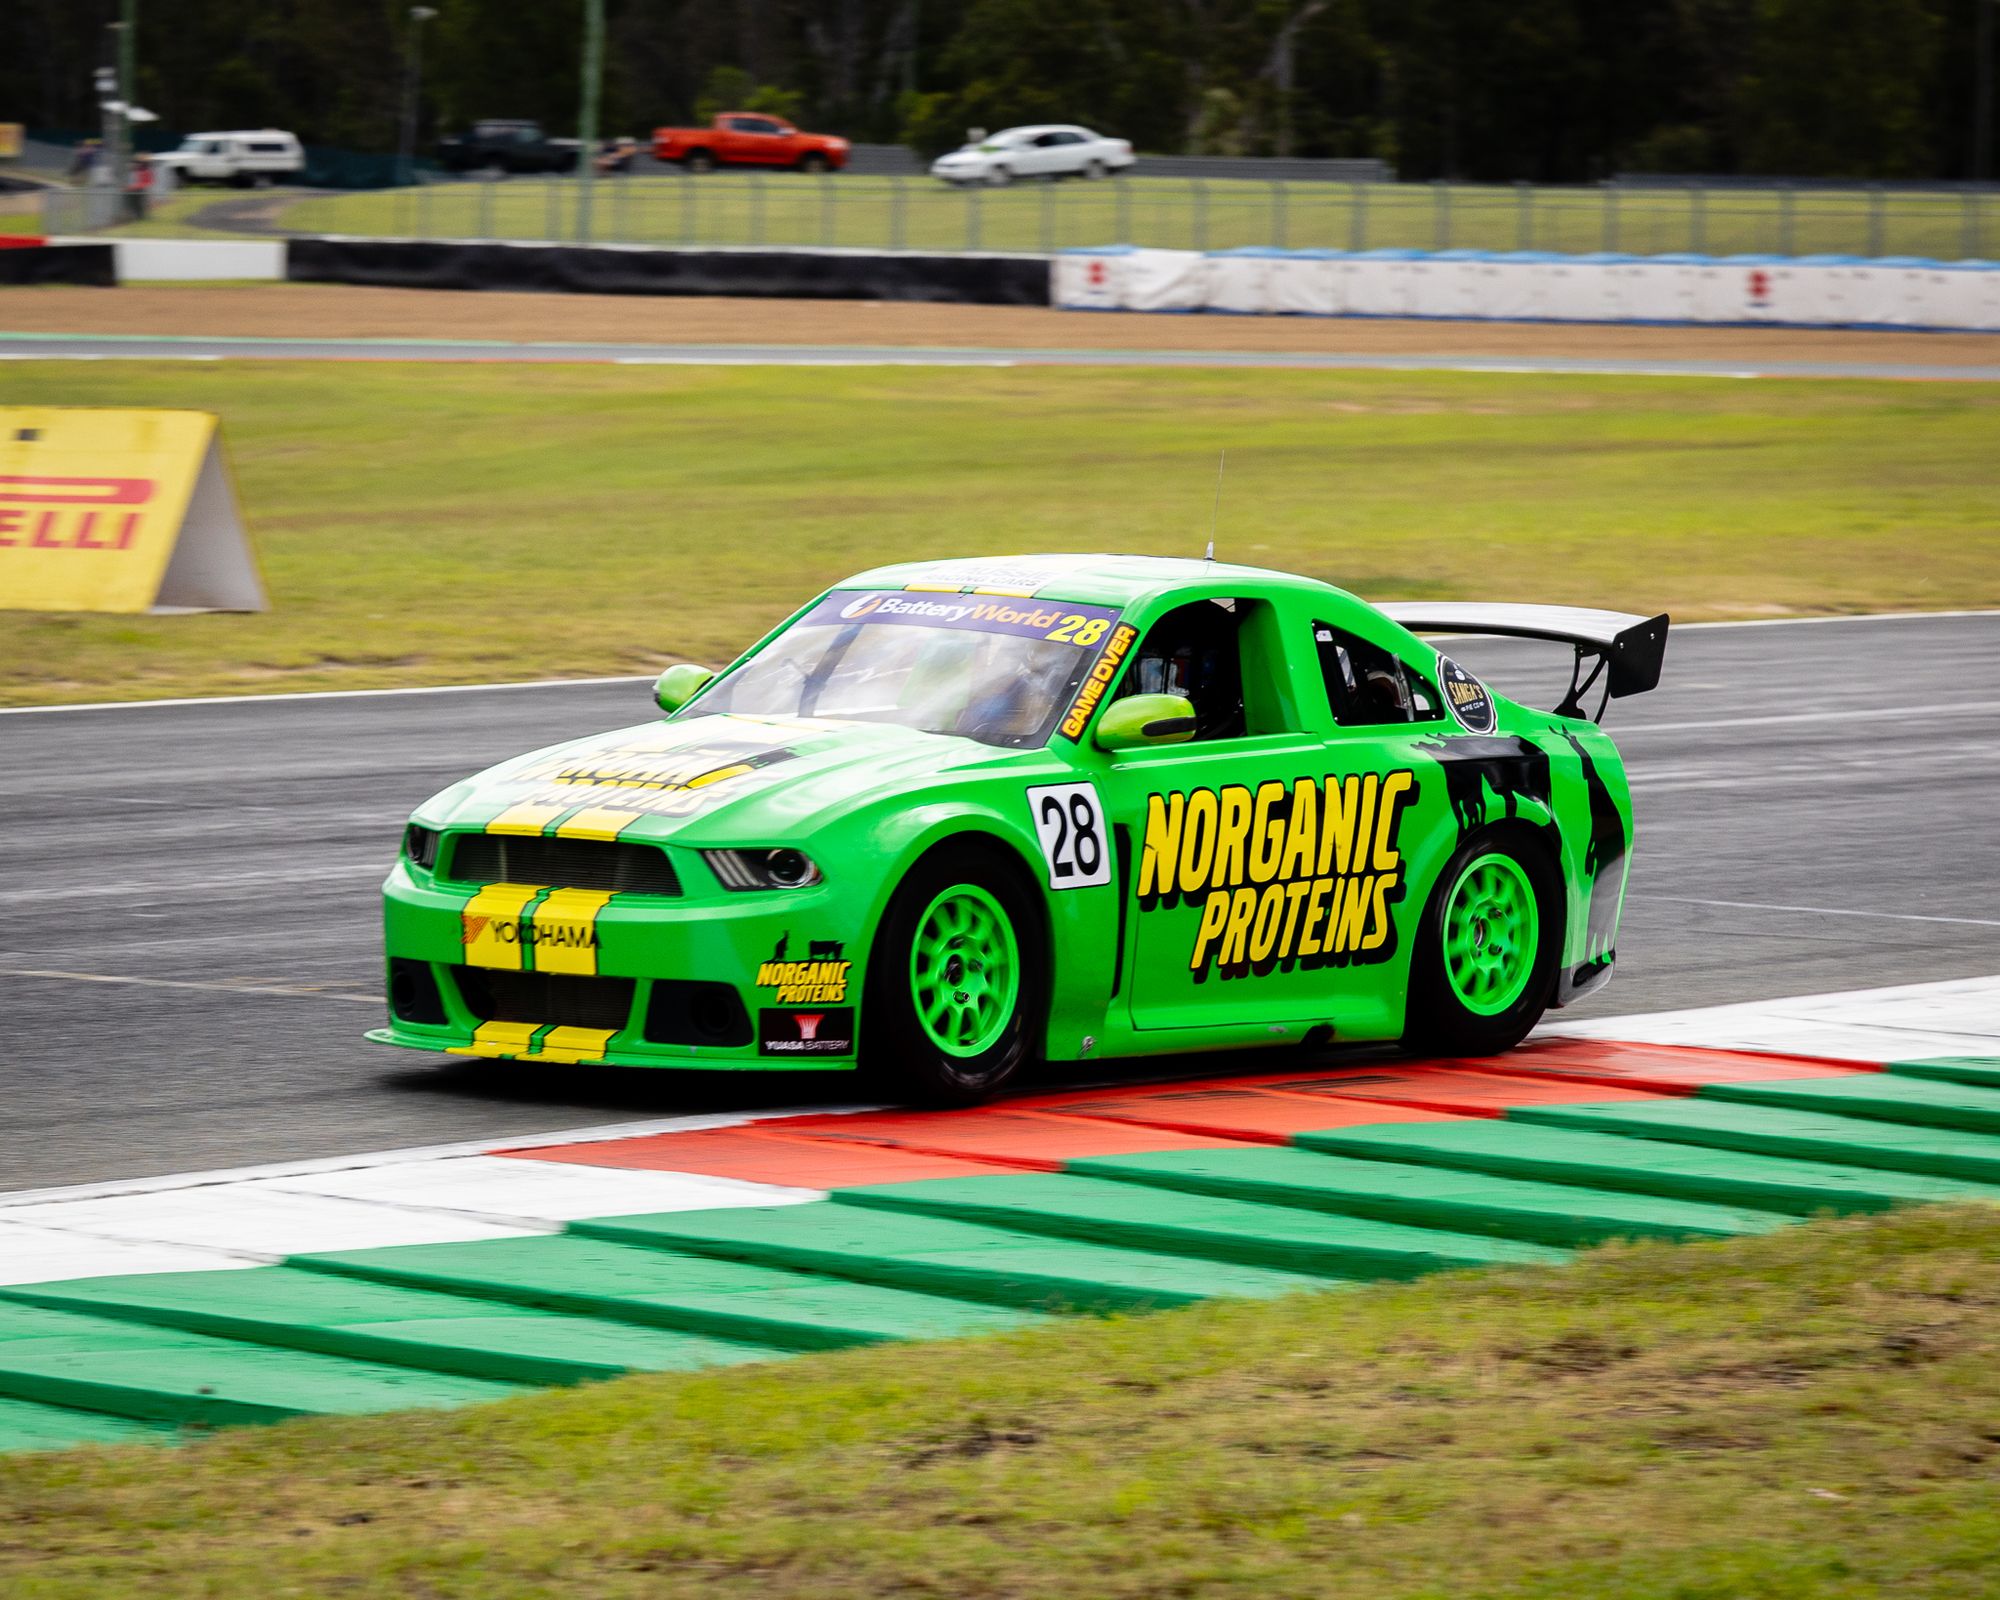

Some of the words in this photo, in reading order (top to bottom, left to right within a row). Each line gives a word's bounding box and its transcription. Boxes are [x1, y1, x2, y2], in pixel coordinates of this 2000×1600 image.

[1044, 614, 1111, 646] 28
[1447, 681, 1484, 705] SANGA'S
[1042, 793, 1100, 878] 28
[1137, 771, 1414, 898] NORGANIC
[490, 920, 602, 949] YOKOHAMA
[1190, 872, 1400, 970] PROTEINS
[756, 961, 852, 986] NORGANIC
[776, 984, 847, 1003] PROTEINS
